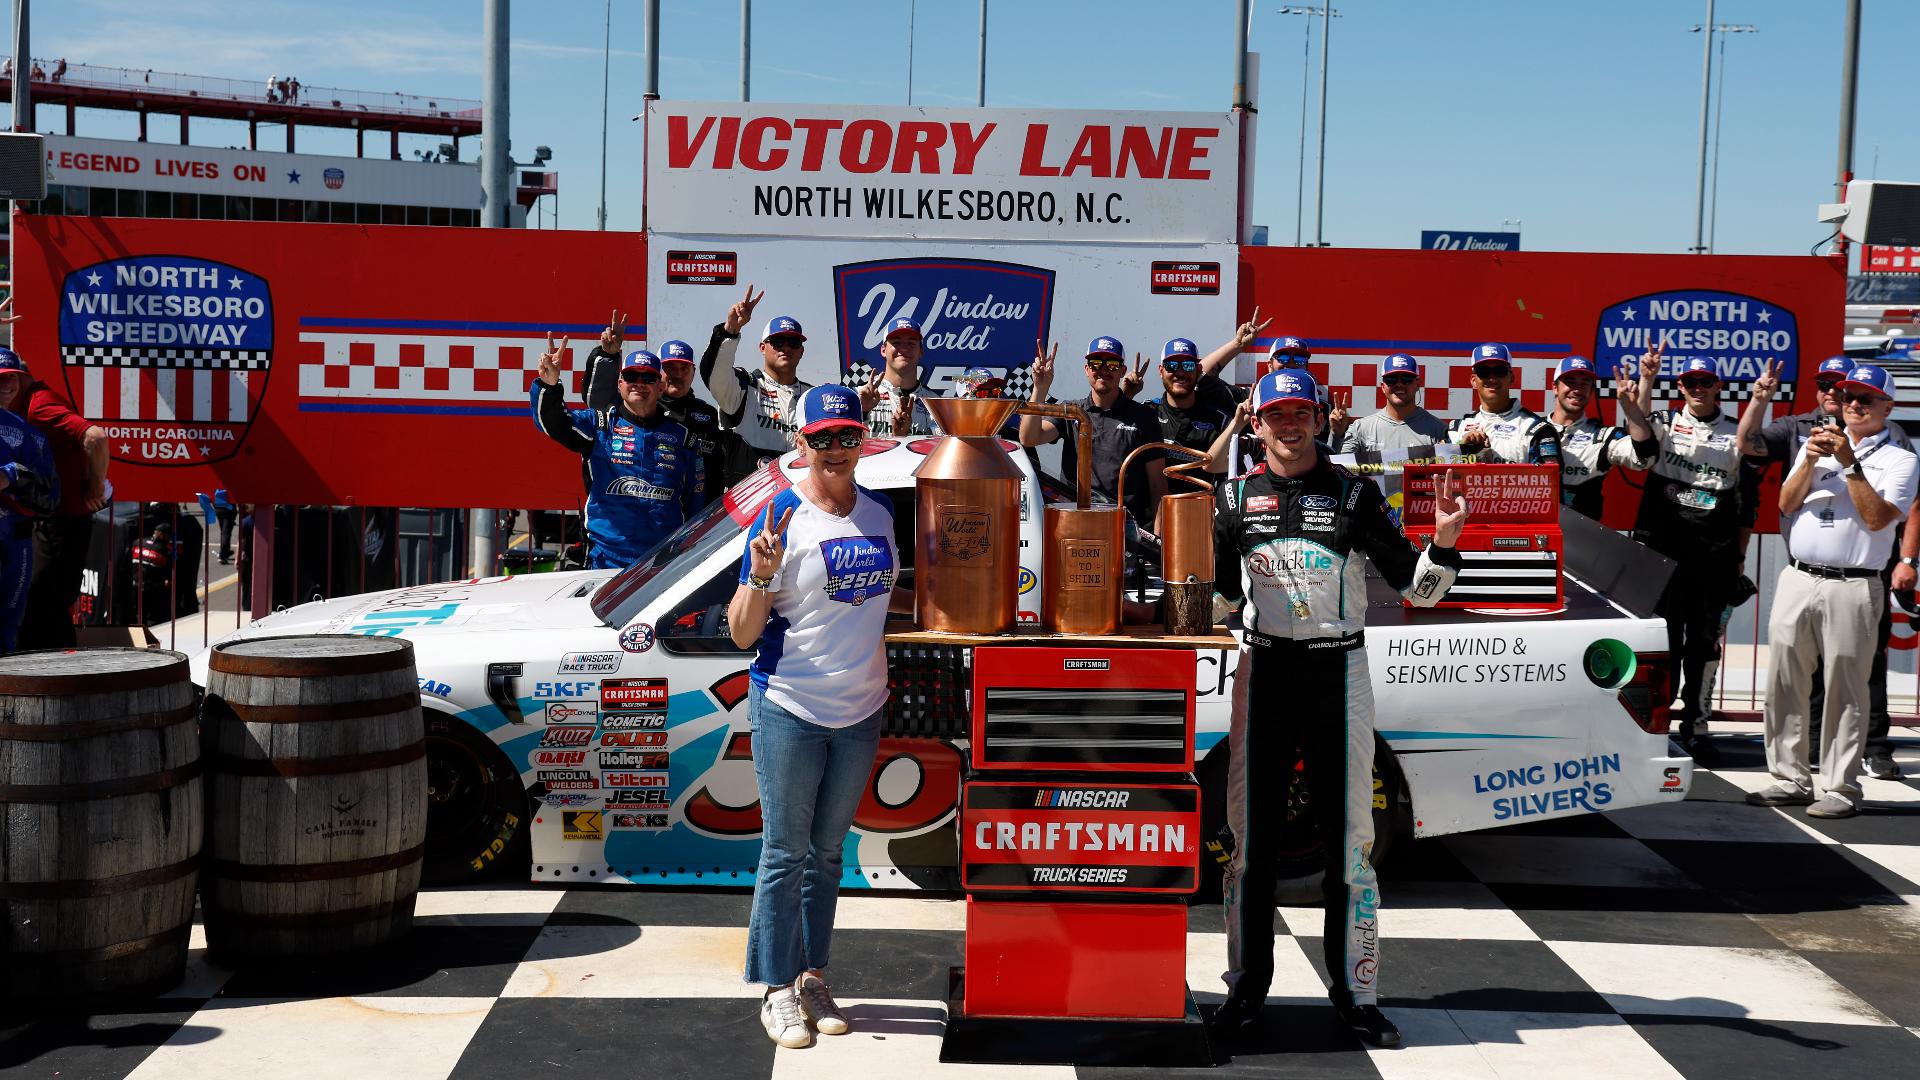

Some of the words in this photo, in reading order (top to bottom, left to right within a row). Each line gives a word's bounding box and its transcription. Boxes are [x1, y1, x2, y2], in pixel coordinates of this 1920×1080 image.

[667, 115, 997, 175] VICTORY
[1019, 124, 1220, 180] LANE
[48, 151, 140, 174] EGEND
[155, 159, 219, 179] LIVES
[234, 165, 266, 182] ON
[754, 185, 851, 218] NORTH
[864, 187, 1063, 225] WILKESBORO,
[1076, 192, 1131, 224] N.C.
[670, 263, 732, 273] CRAFTSMAN
[116, 265, 218, 288] NORTH
[1155, 273, 1216, 283] CRAFTSMAN
[68, 293, 264, 319] WILKESBORO
[1650, 300, 1748, 322] NORTH
[87, 321, 248, 346] SPEEDWAY
[1604, 327, 1791, 351] WILKESBORO
[1620, 355, 1773, 378] SEEWAY
[155, 428, 235, 441] CAROLINA
[141, 442, 190, 460] USA
[1450, 454, 1477, 465] 250
[1466, 475, 1549, 486] CRAFTSMAN
[1466, 487, 1500, 499] 2025
[1502, 487, 1551, 499] WINNER
[1305, 497, 1330, 507] Ford
[1409, 500, 1437, 514] NOR
[1071, 549, 1101, 558] BORN
[1079, 562, 1092, 571] TO
[1249, 551, 1332, 577] QuickTie
[841, 570, 882, 590] 250
[1070, 574, 1101, 584] SHINE
[1308, 641, 1340, 650] CHANDLER
[1388, 639, 1442, 657] HIGH
[1449, 638, 1507, 656] WIND
[1513, 637, 1528, 655] &
[587, 663, 614, 671] TRUCK
[1066, 660, 1108, 668] CRAFTSMAN
[1385, 664, 1469, 684] SEISMIC
[1475, 663, 1567, 684] SYSTEMS
[534, 682, 595, 698] SKF
[604, 689, 664, 699] CRAFTSMAN
[603, 713, 665, 727] COMETIC
[548, 729, 591, 742] KLOTZ
[601, 732, 668, 746] CALICO
[600, 753, 643, 769] Holley
[540, 771, 588, 780] LINCOLN
[607, 773, 665, 786] tilton
[1473, 765, 1545, 794] LONG
[1554, 753, 1621, 784] JOHN
[551, 781, 594, 789] WELDERS
[605, 790, 670, 803] JESEL
[1057, 790, 1130, 808] NASCAR
[1492, 783, 1613, 820] SILVER'S
[975, 822, 1185, 852] CRAFTSMAN
[1033, 867, 1078, 883] TRUCK
[1078, 868, 1128, 884] SERIES
